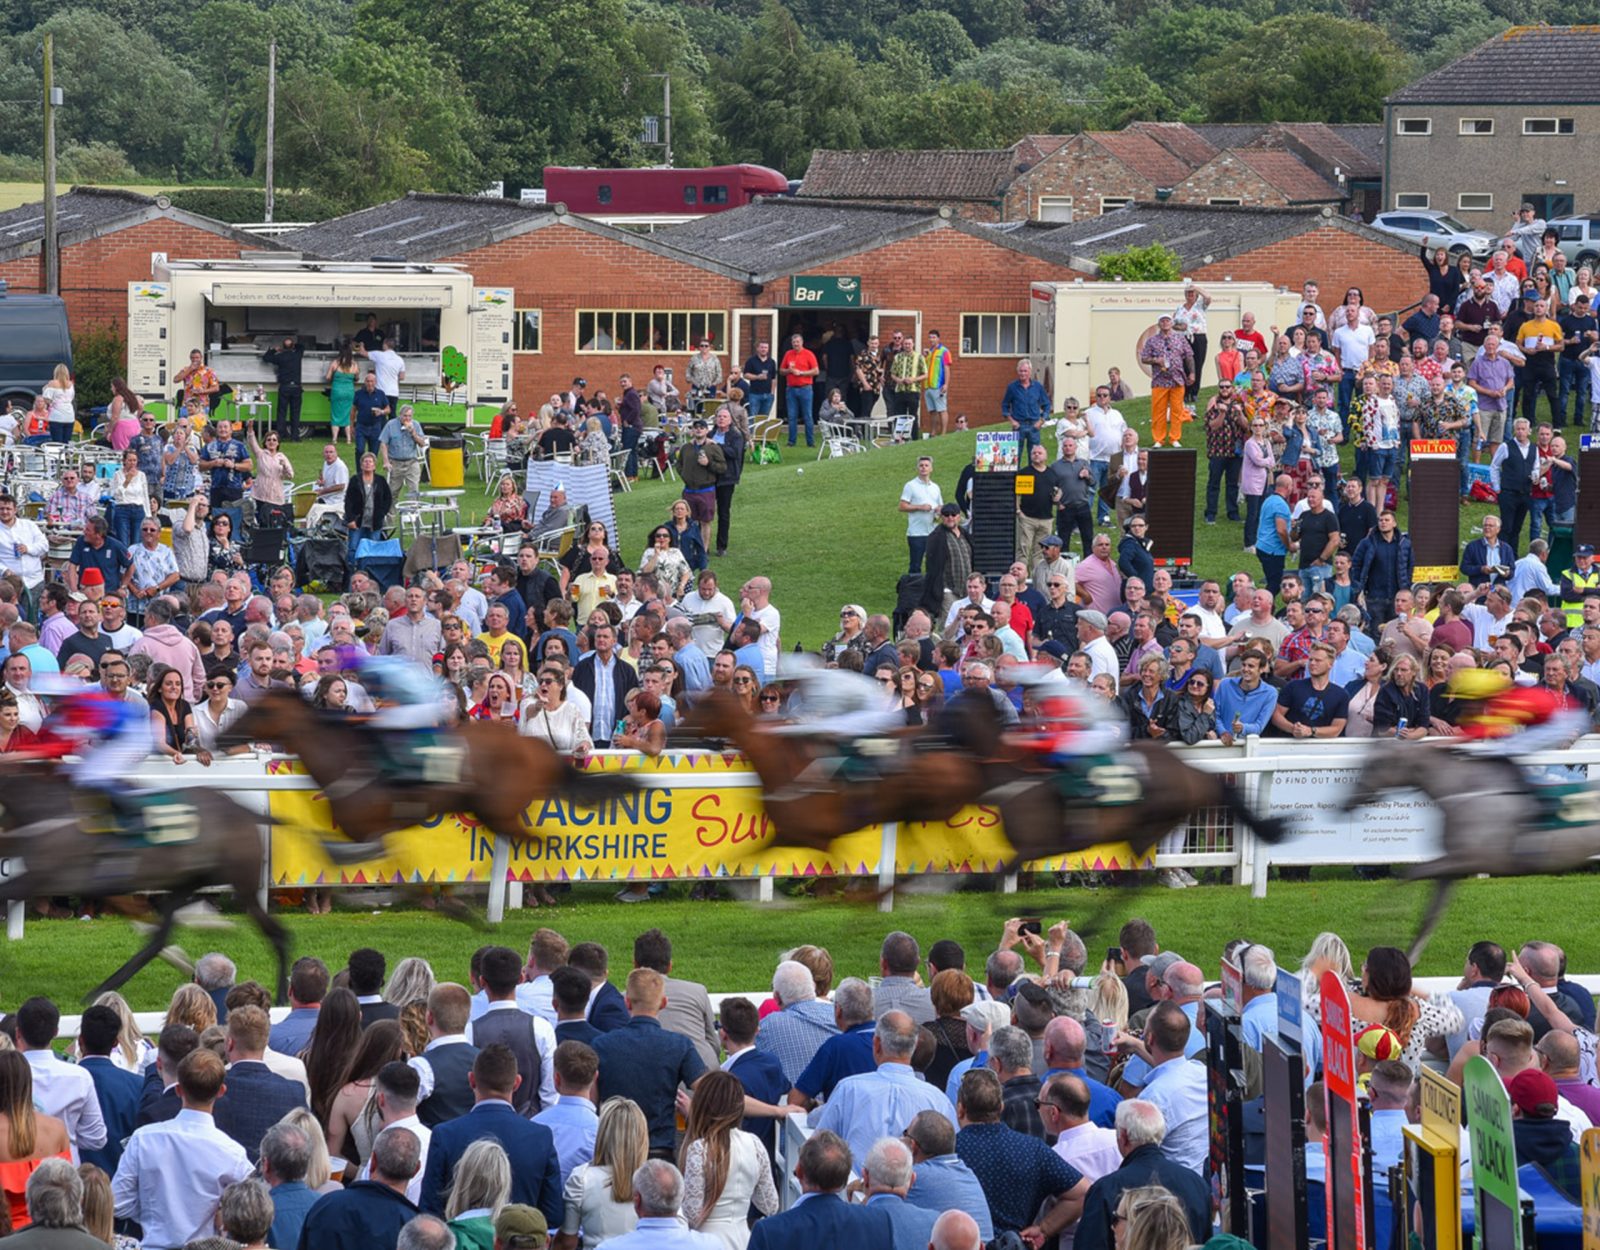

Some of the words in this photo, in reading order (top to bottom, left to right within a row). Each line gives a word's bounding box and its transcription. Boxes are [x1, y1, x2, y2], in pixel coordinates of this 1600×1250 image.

[795, 287, 824, 301] Bar
[1412, 444, 1456, 453] WILTON
[509, 833, 668, 861] YORKSHIRE
[1326, 1035, 1350, 1085] BLACK
[1472, 1084, 1504, 1132] SAMUEL
[1476, 1127, 1510, 1185] BLACK
